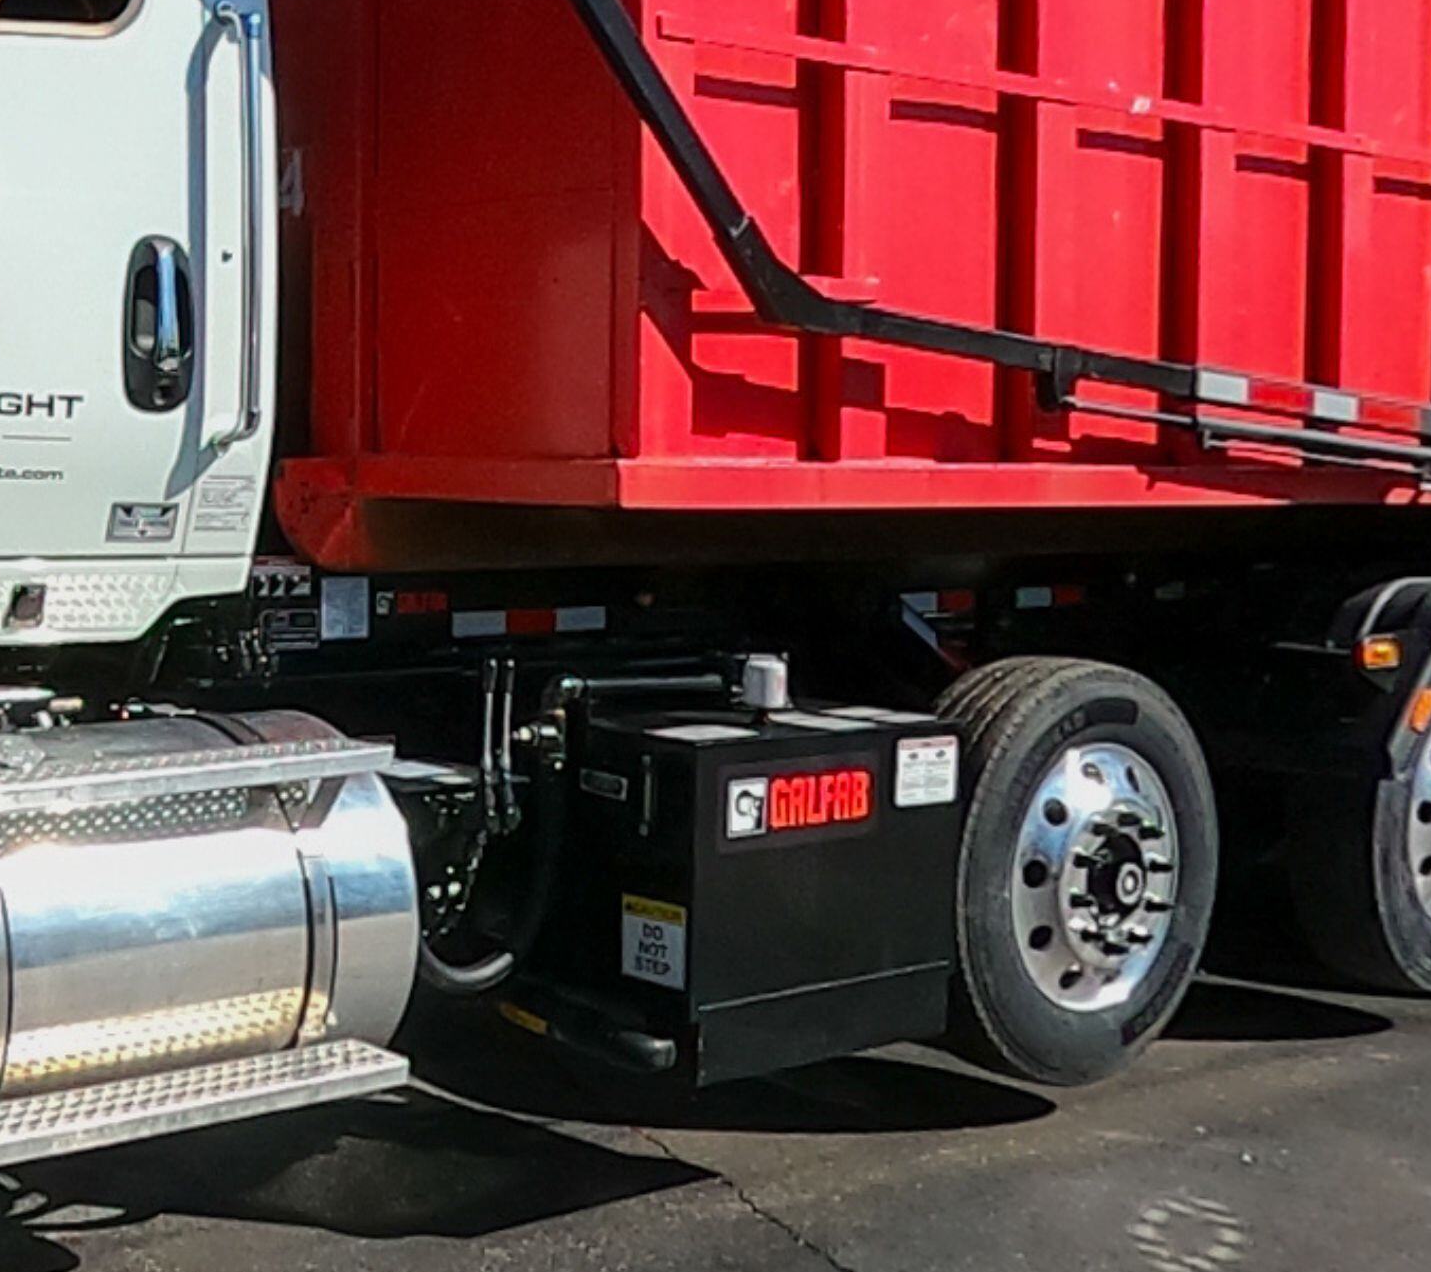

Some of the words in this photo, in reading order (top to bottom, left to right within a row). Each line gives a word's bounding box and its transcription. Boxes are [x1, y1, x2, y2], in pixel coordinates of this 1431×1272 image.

[770, 770, 871, 829] GALFAB
[642, 922, 664, 941] DO
[638, 939, 668, 958] NOT
[634, 955, 672, 975] STEP
